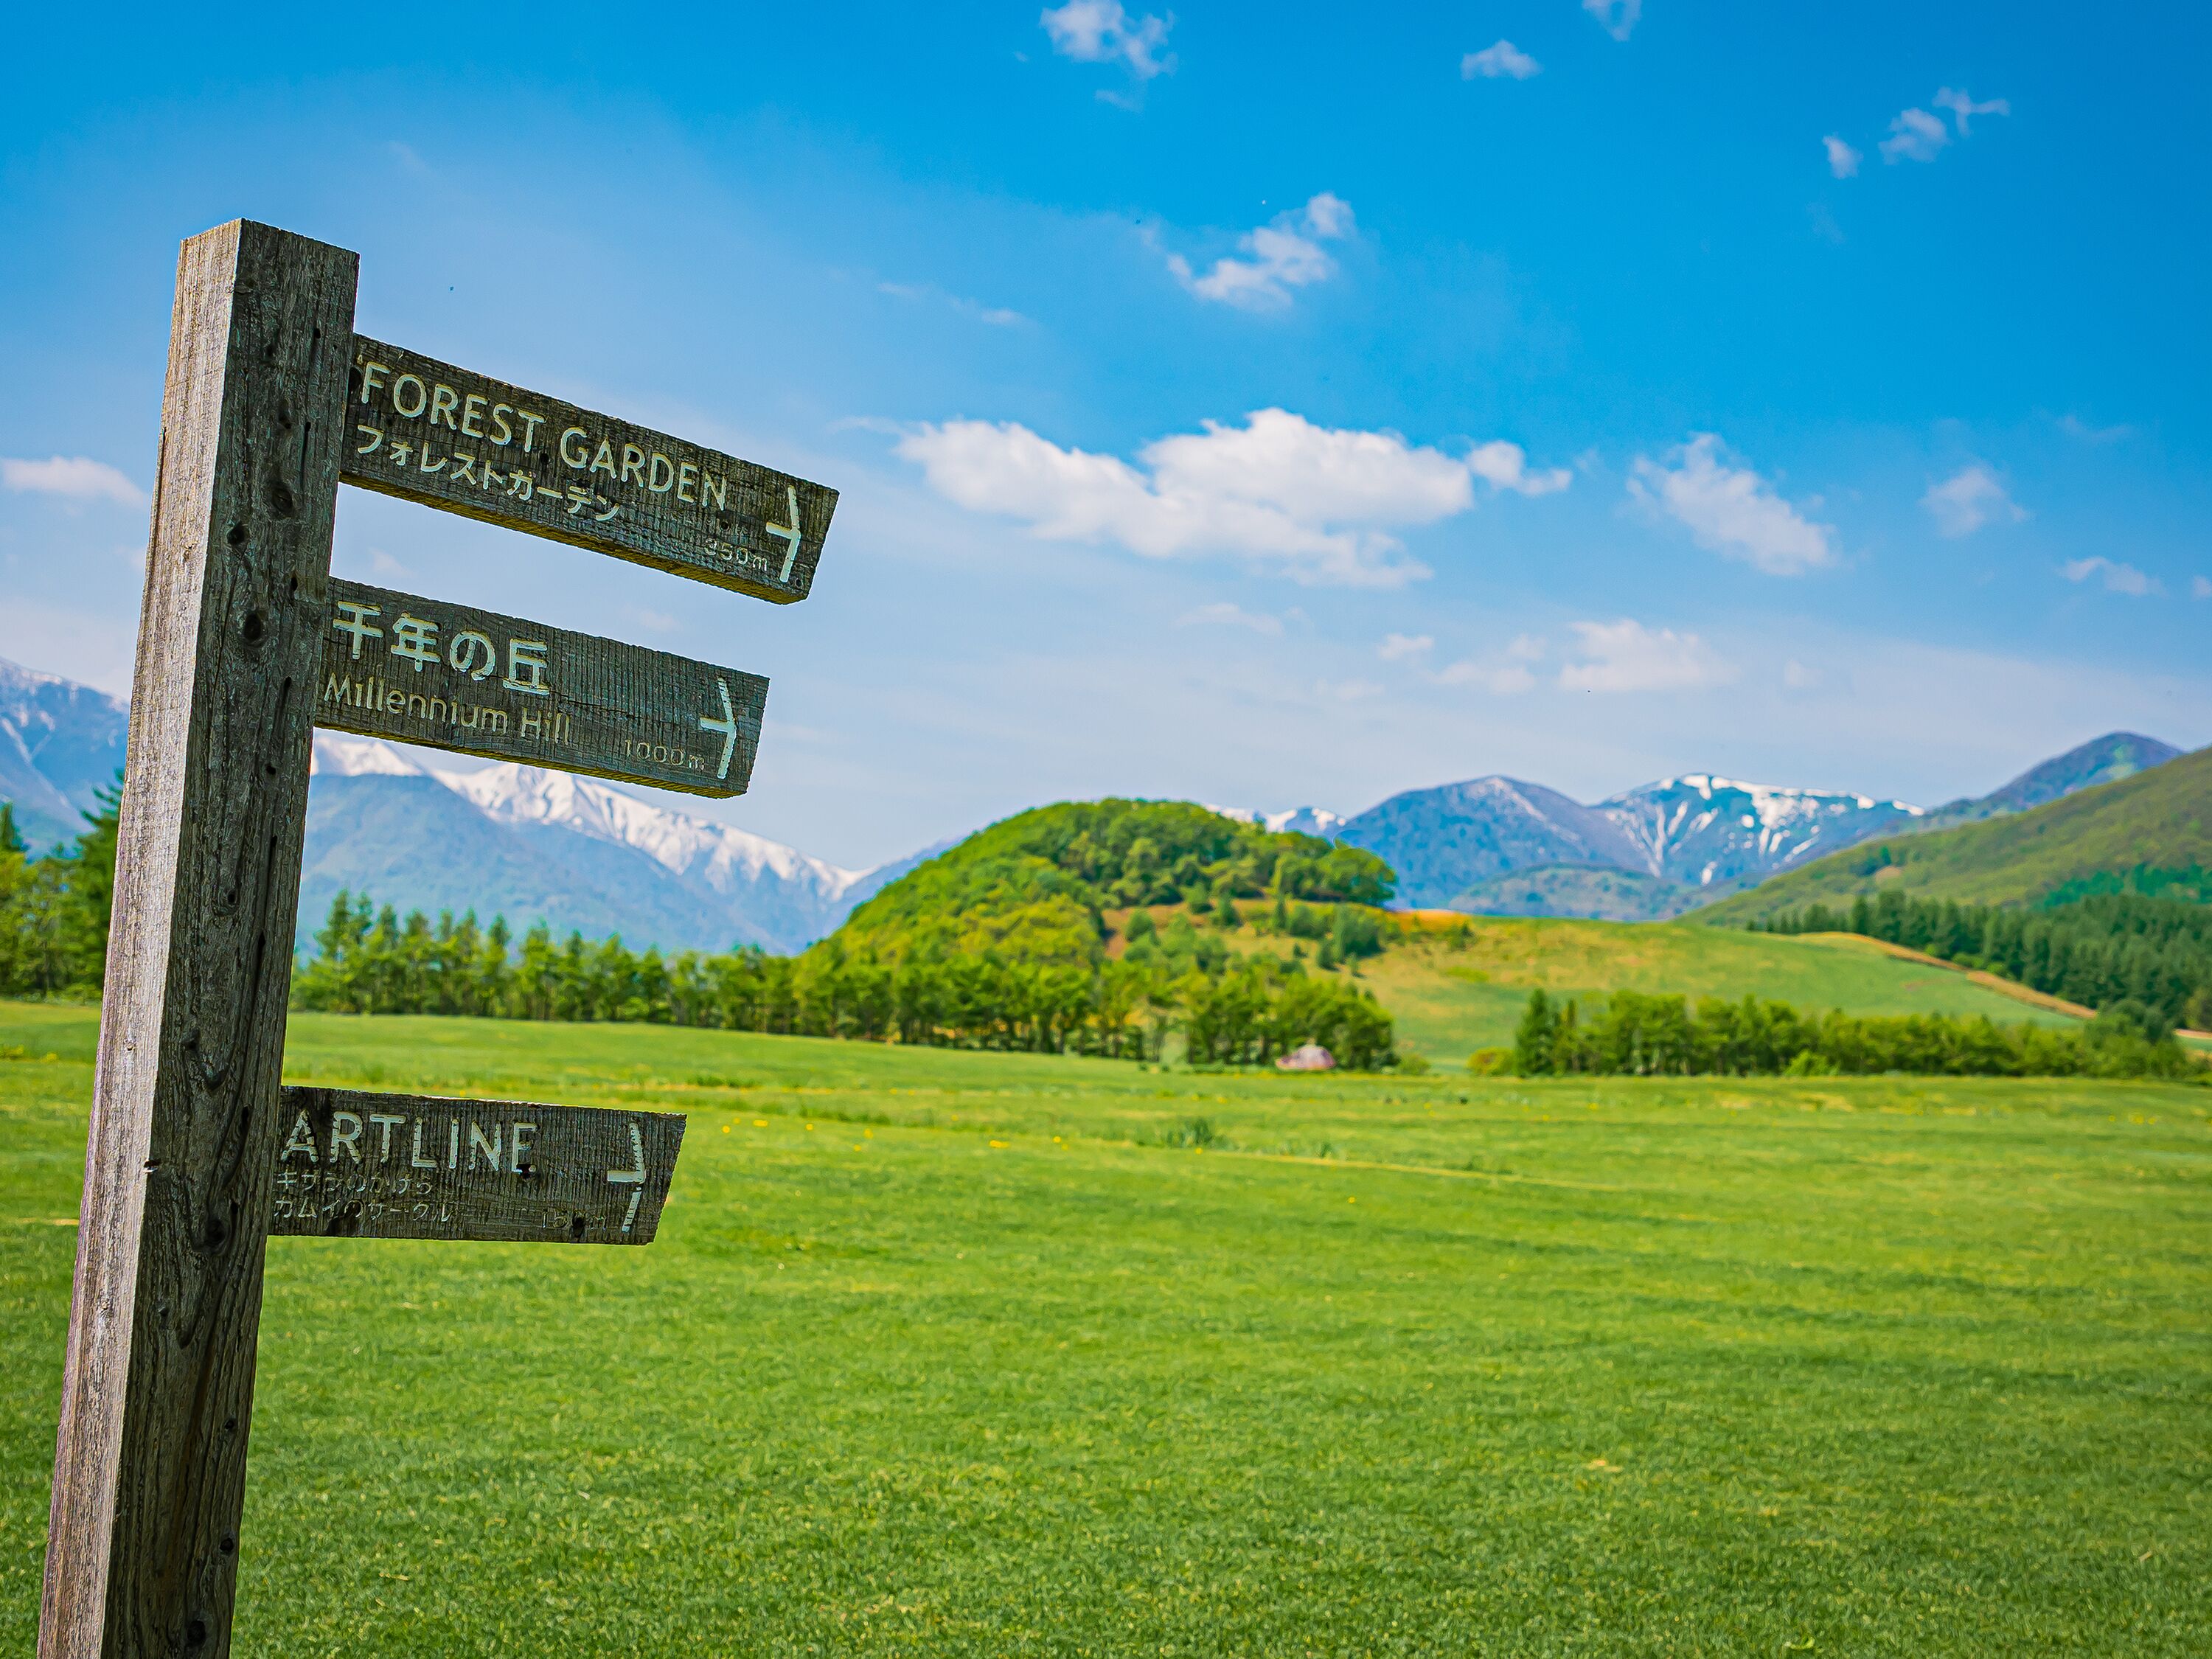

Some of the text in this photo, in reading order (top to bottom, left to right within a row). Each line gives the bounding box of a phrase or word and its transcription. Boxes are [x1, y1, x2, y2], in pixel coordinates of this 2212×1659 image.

[357, 424, 620, 522] フォレストガーデン
[361, 361, 728, 512] FOREST GARDEN
[703, 538, 768, 572] 350m
[332, 601, 551, 697] 千年の丘
[324, 672, 572, 745] Millennium Hill
[281, 1107, 539, 1174] ARTLINE
